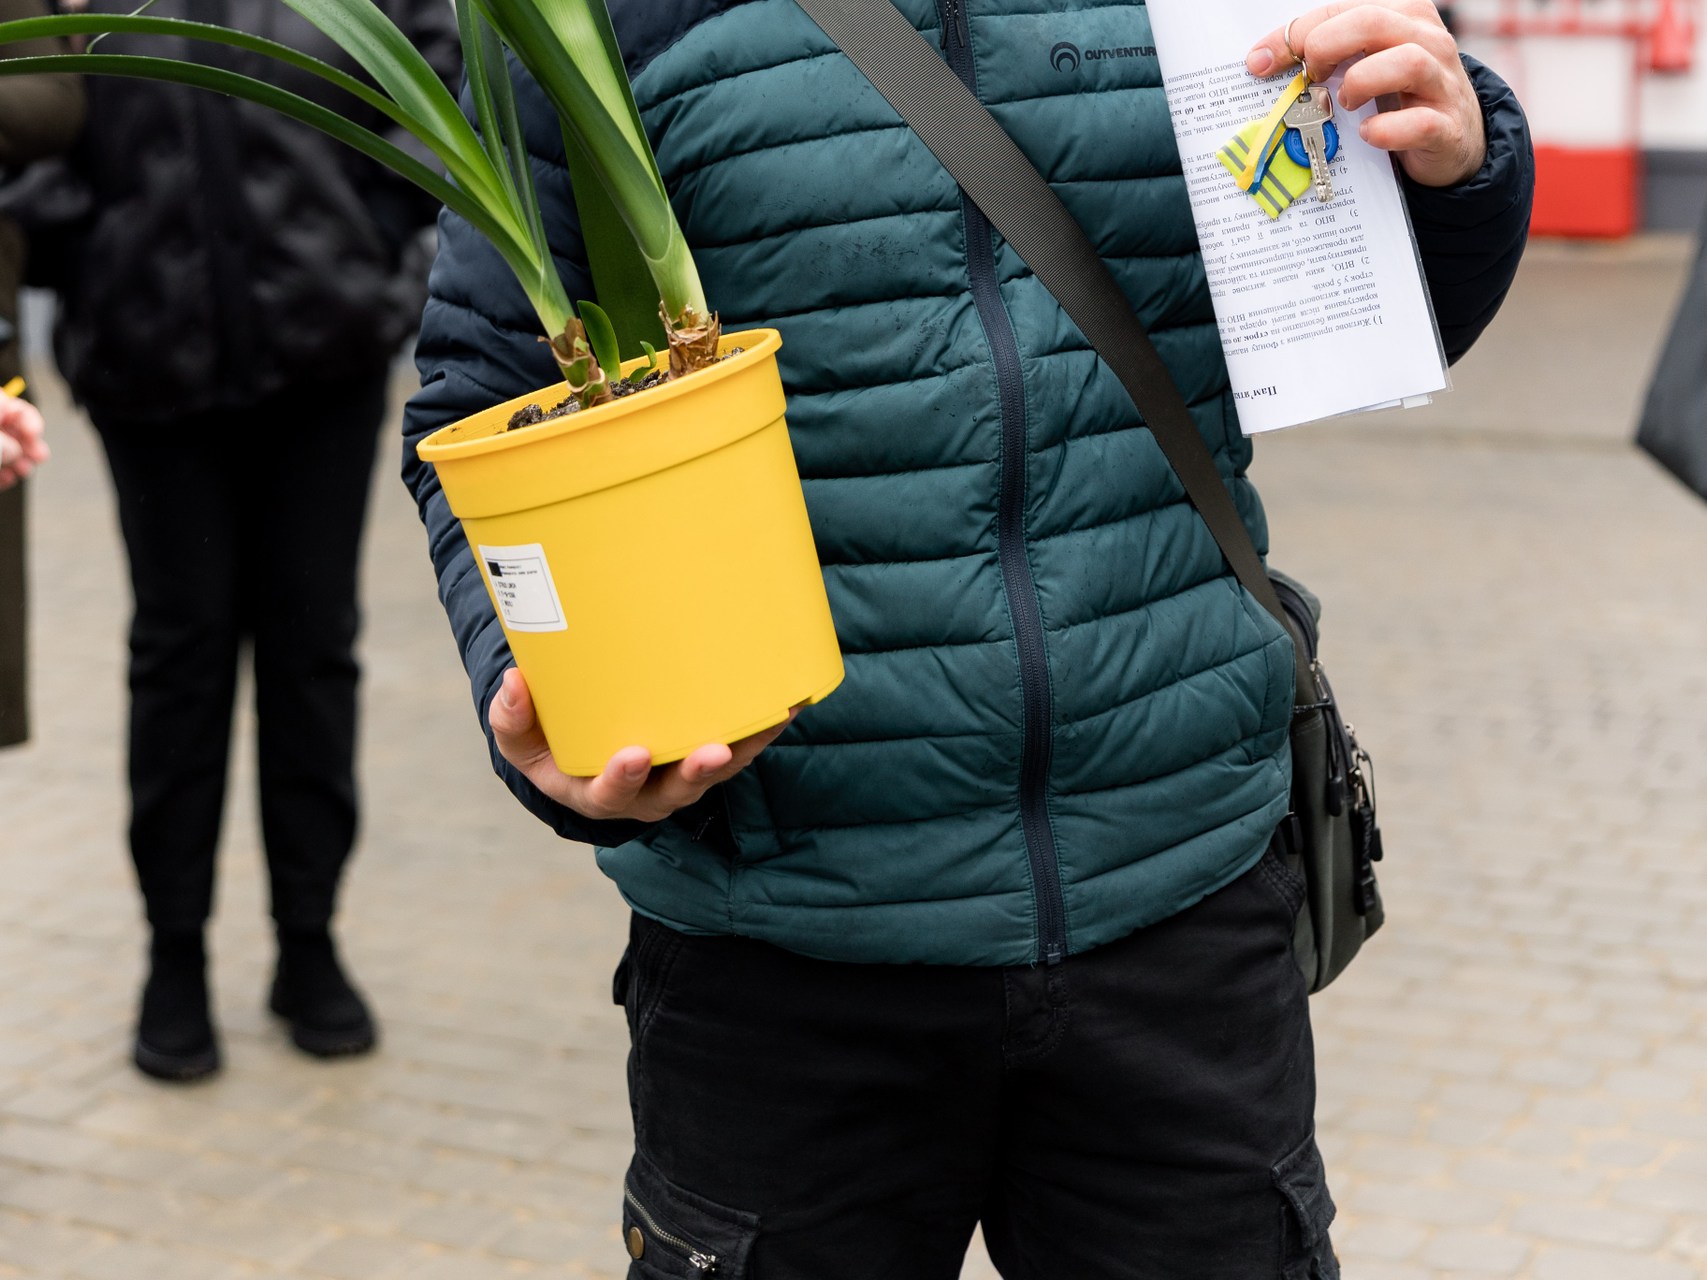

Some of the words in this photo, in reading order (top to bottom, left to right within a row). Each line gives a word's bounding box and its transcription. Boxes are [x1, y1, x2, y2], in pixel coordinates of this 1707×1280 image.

[1209, 87, 1229, 98] ВПО
[1185, 107, 1194, 115] 60
[1340, 166, 1348, 174] 4)
[1350, 209, 1358, 217] 3)
[1315, 215, 1335, 225] ВПО
[1221, 223, 1250, 235] правил
[1313, 230, 1338, 240] інших
[1350, 234, 1364, 243] для
[1296, 238, 1348, 256] провадження
[1332, 260, 1355, 271] ВПО,
[1361, 256, 1370, 265] 2)
[1305, 267, 1325, 277] яким
[1350, 271, 1373, 281] строк
[1273, 273, 1299, 285] надане
[1337, 278, 1342, 287] 5
[1232, 281, 1266, 294] житлове
[1343, 282, 1375, 294] надання
[1299, 290, 1340, 305] житлового
[1324, 293, 1378, 310] користування
[1248, 300, 1297, 318] приміщення
[1327, 304, 1381, 321] користування
[1227, 313, 1246, 324] ВПО
[1373, 314, 1383, 325] 1)
[1239, 319, 1267, 331] ордера
[1335, 318, 1371, 331] Житлове
[1244, 331, 1268, 341] строк
[1252, 341, 1279, 352] Фонду
